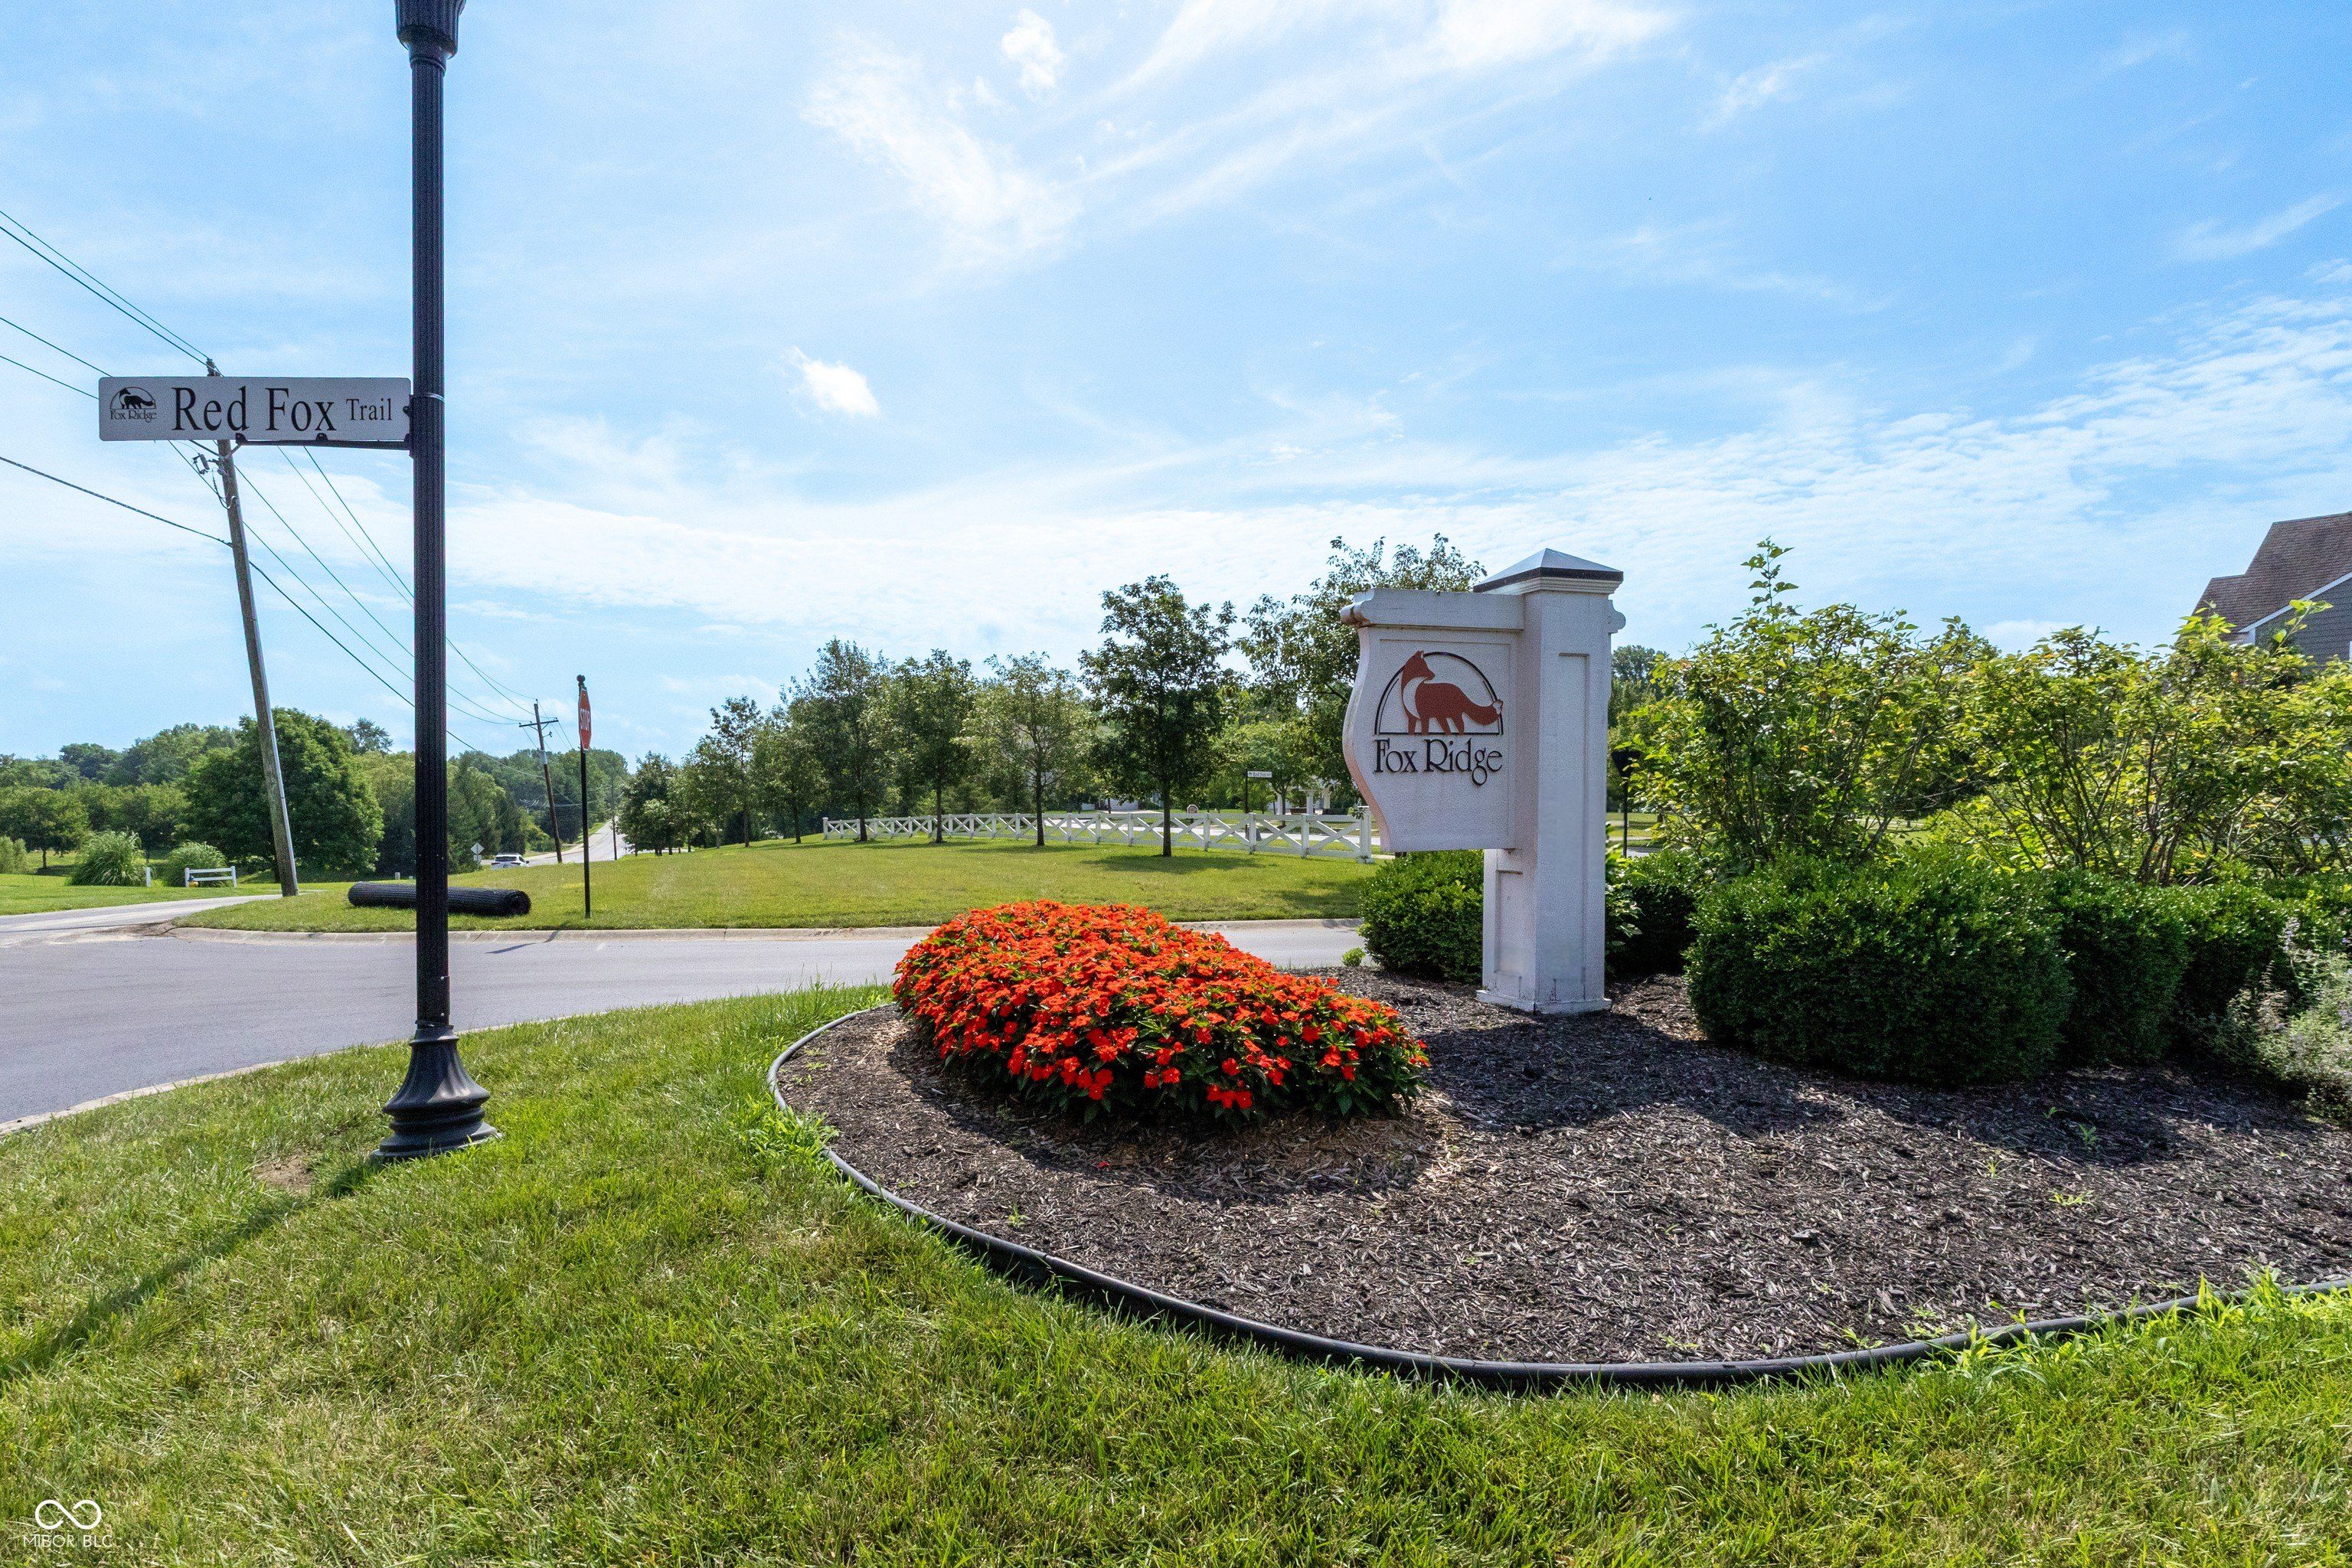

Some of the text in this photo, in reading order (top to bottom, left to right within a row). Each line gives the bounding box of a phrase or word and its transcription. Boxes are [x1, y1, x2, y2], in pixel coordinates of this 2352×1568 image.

[110, 410, 157, 423] Fox Ridge
[172, 386, 393, 431] Red Fox Trail
[580, 707, 590, 731] STOP
[1374, 738, 1503, 786] Fox Ridge
